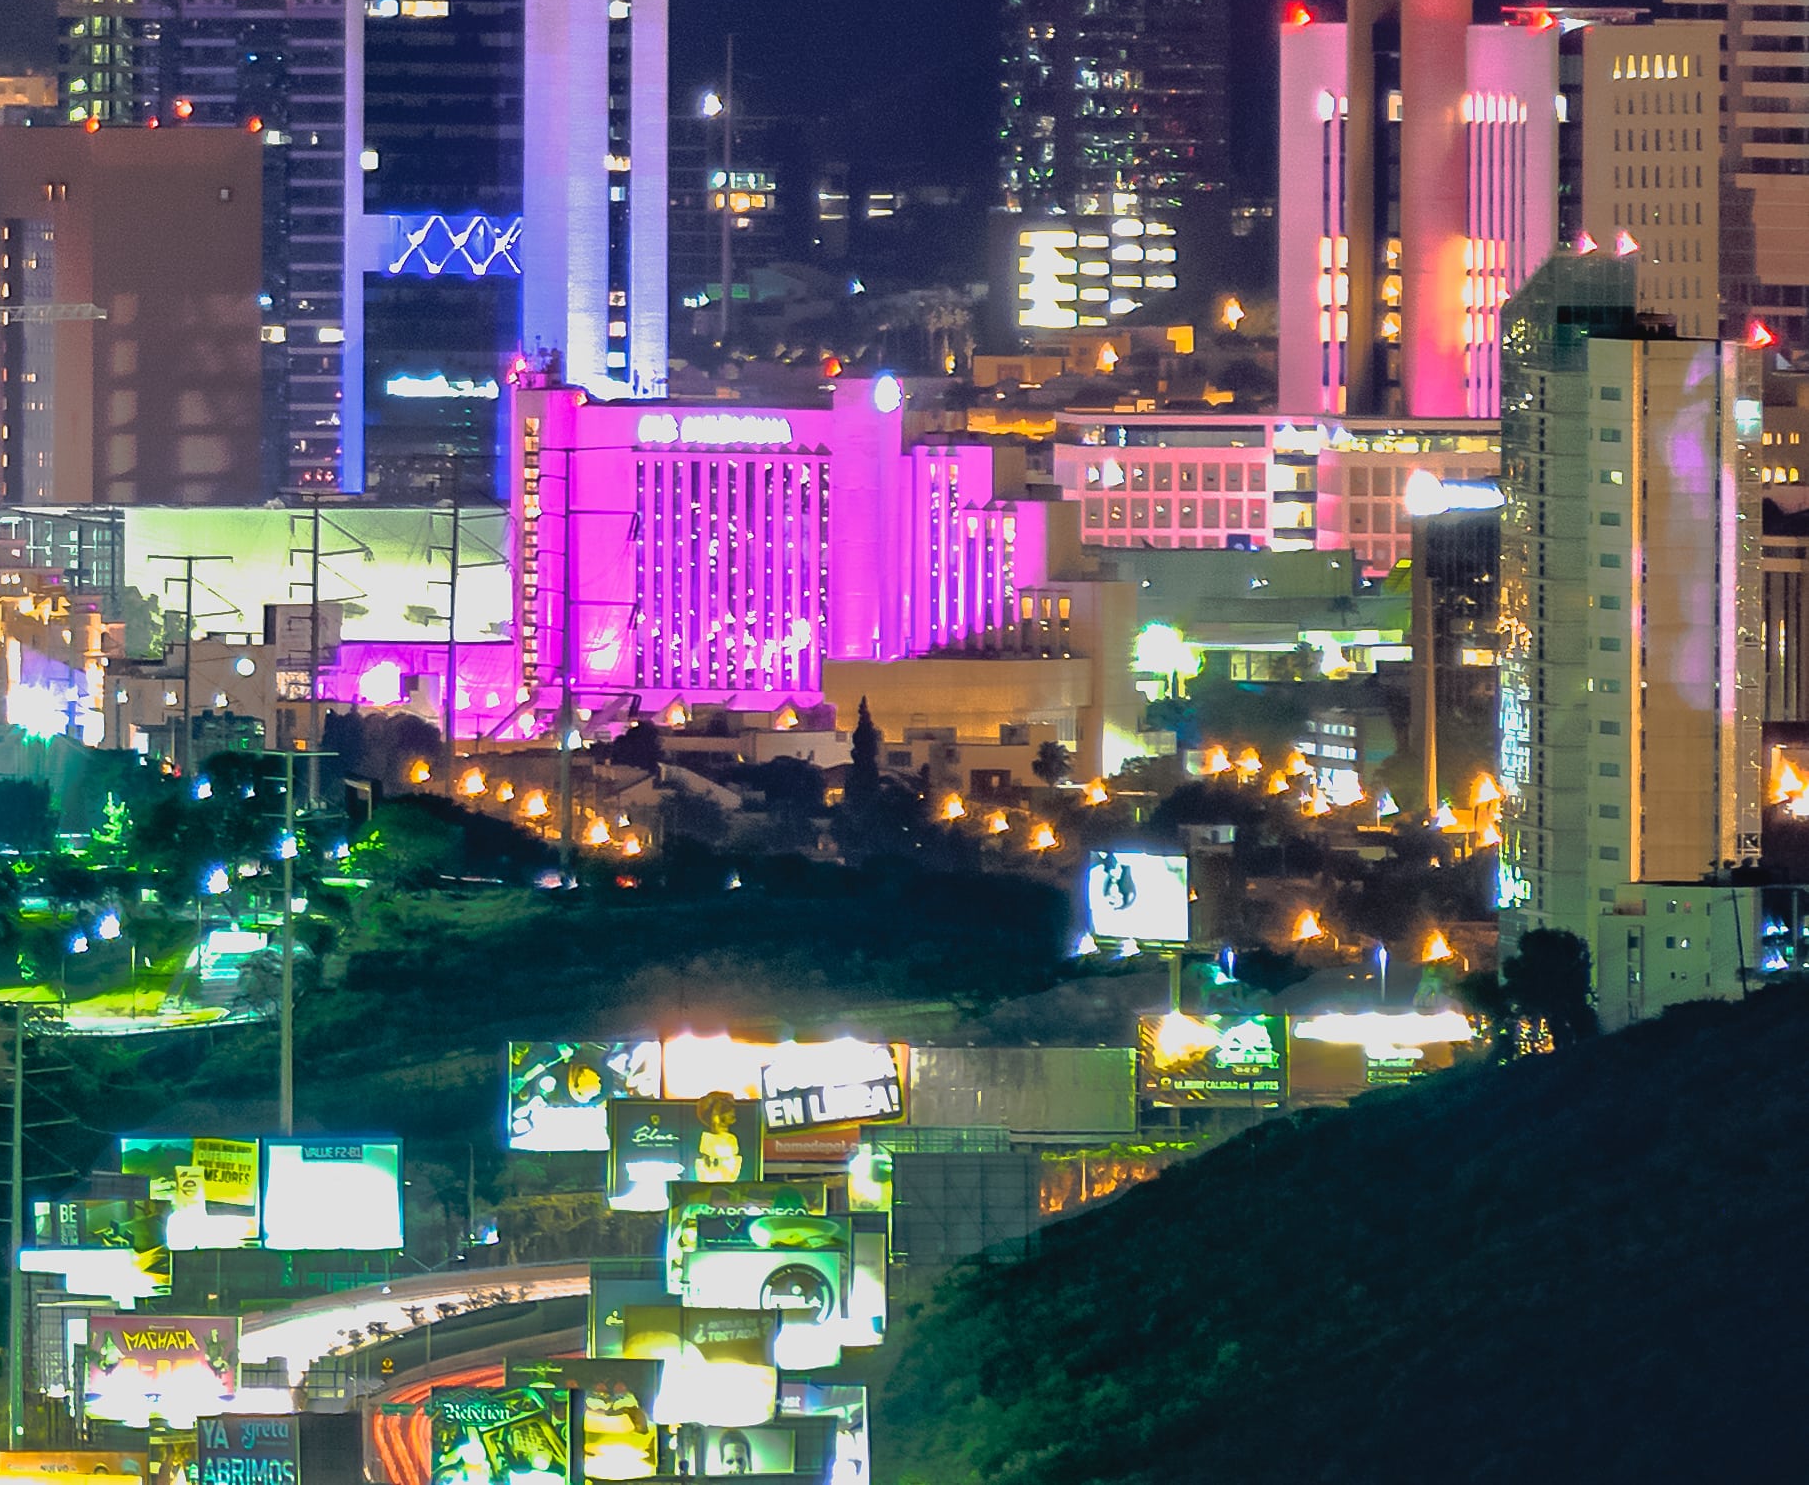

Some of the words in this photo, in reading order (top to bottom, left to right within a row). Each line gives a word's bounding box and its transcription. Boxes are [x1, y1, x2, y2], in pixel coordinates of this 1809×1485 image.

[765, 1096, 805, 1128] EN
[59, 1203, 78, 1223] BE
[122, 1328, 200, 1352] MACHACA
[201, 1419, 230, 1449] YA
[202, 1456, 296, 1485] ABRIMOS
